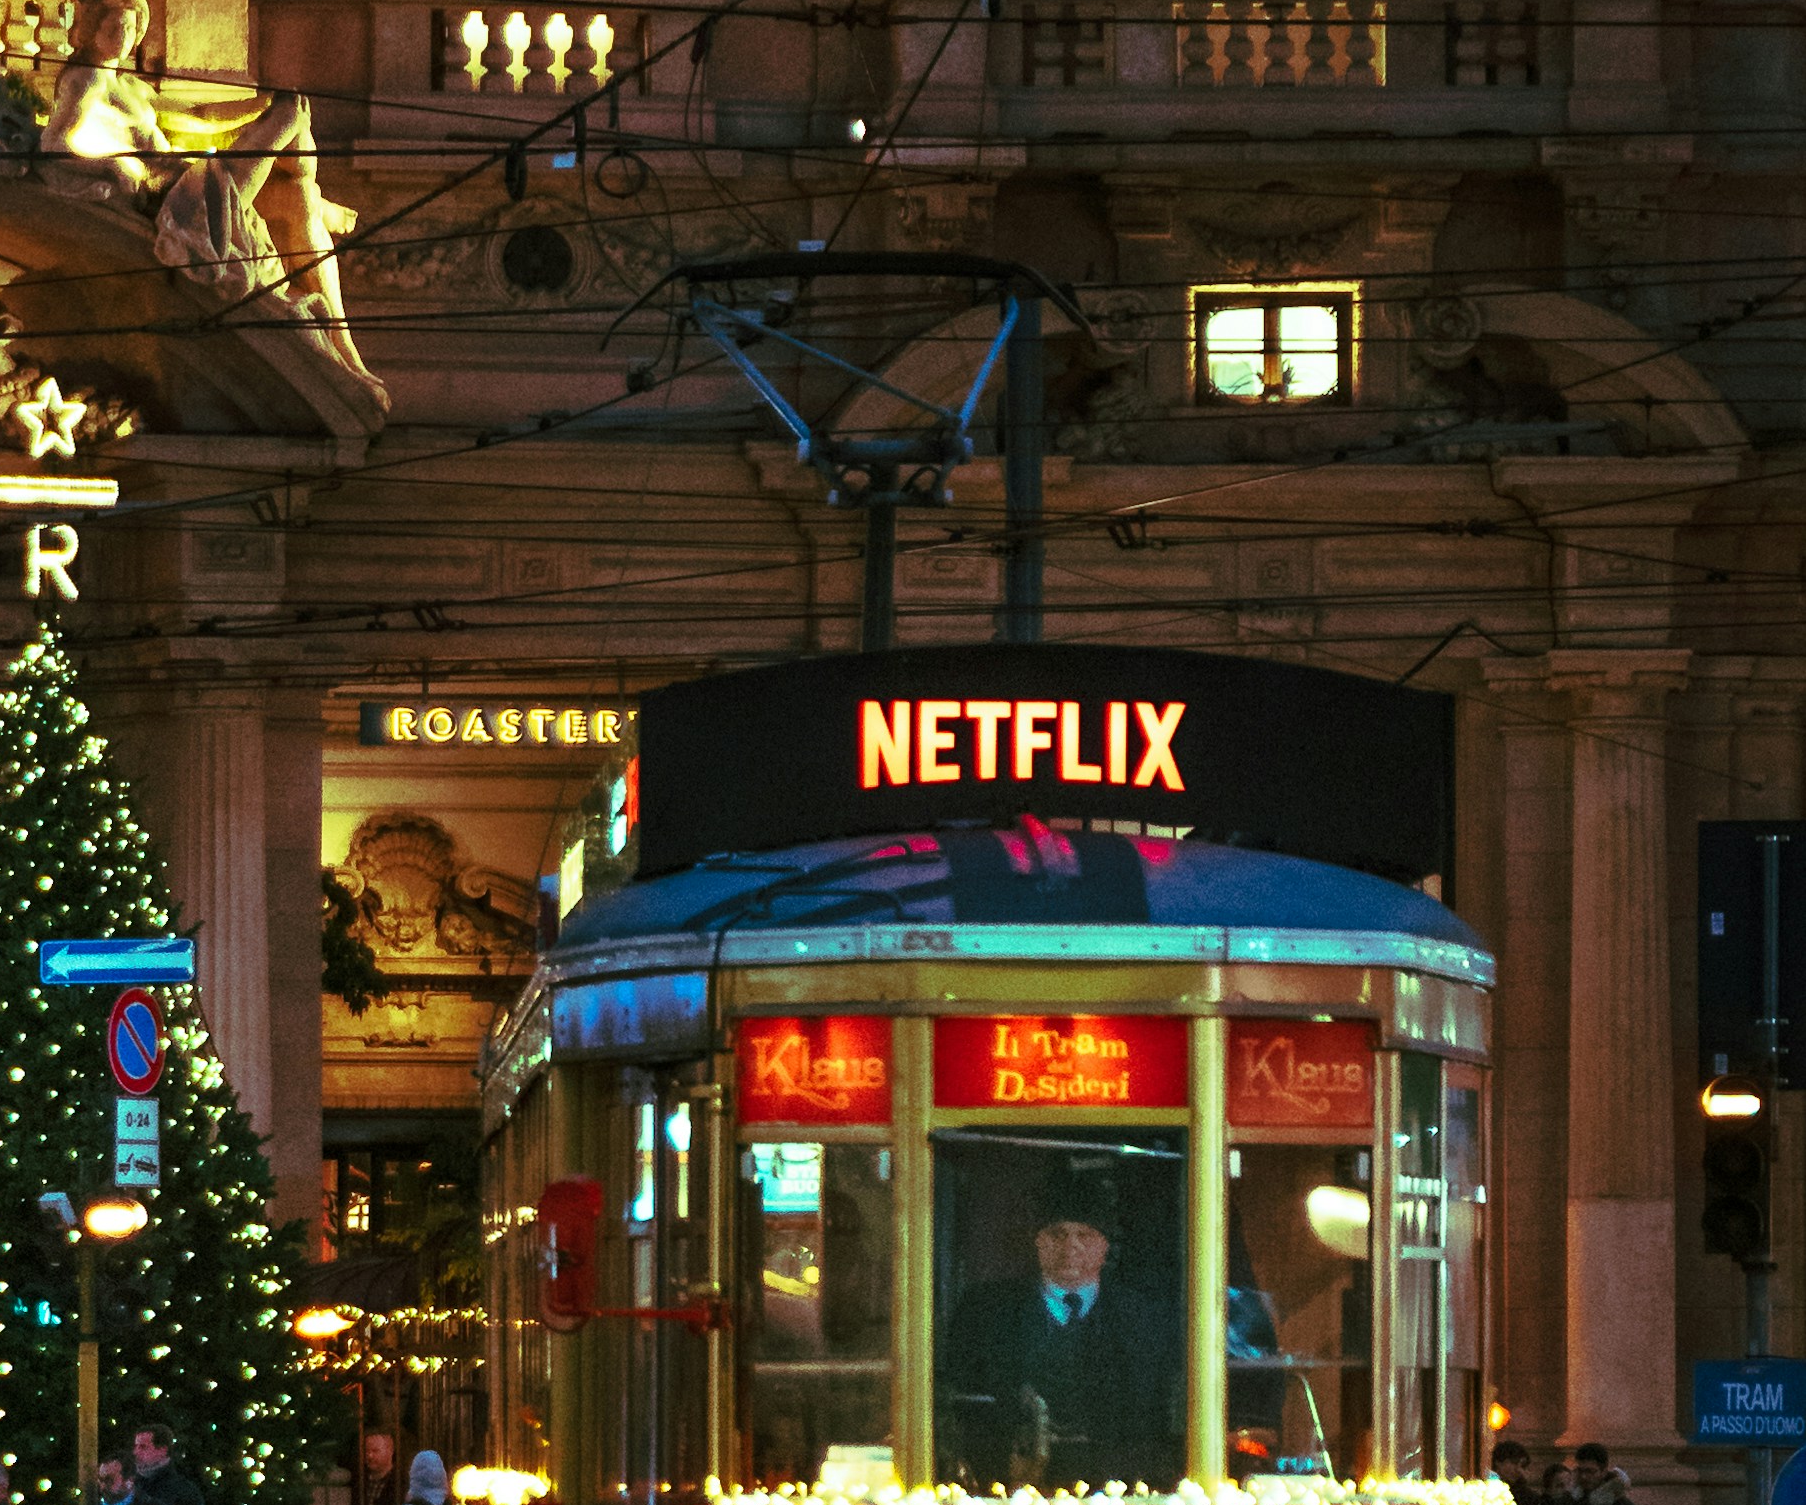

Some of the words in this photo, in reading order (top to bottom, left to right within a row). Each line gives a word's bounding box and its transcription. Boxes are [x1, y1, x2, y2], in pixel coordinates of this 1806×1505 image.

[26, 523, 79, 601] R
[388, 706, 639, 744] ROASTER
[858, 699, 1187, 792] NETFLIX
[1032, 1030, 1131, 1060] Tram
[995, 1068, 1132, 1102] Desideri
[1240, 1036, 1365, 1115] Klaus
[1722, 1382, 1784, 1412] TRAM
[1700, 1415, 1711, 1435] A
[1712, 1415, 1753, 1435] PASSO
